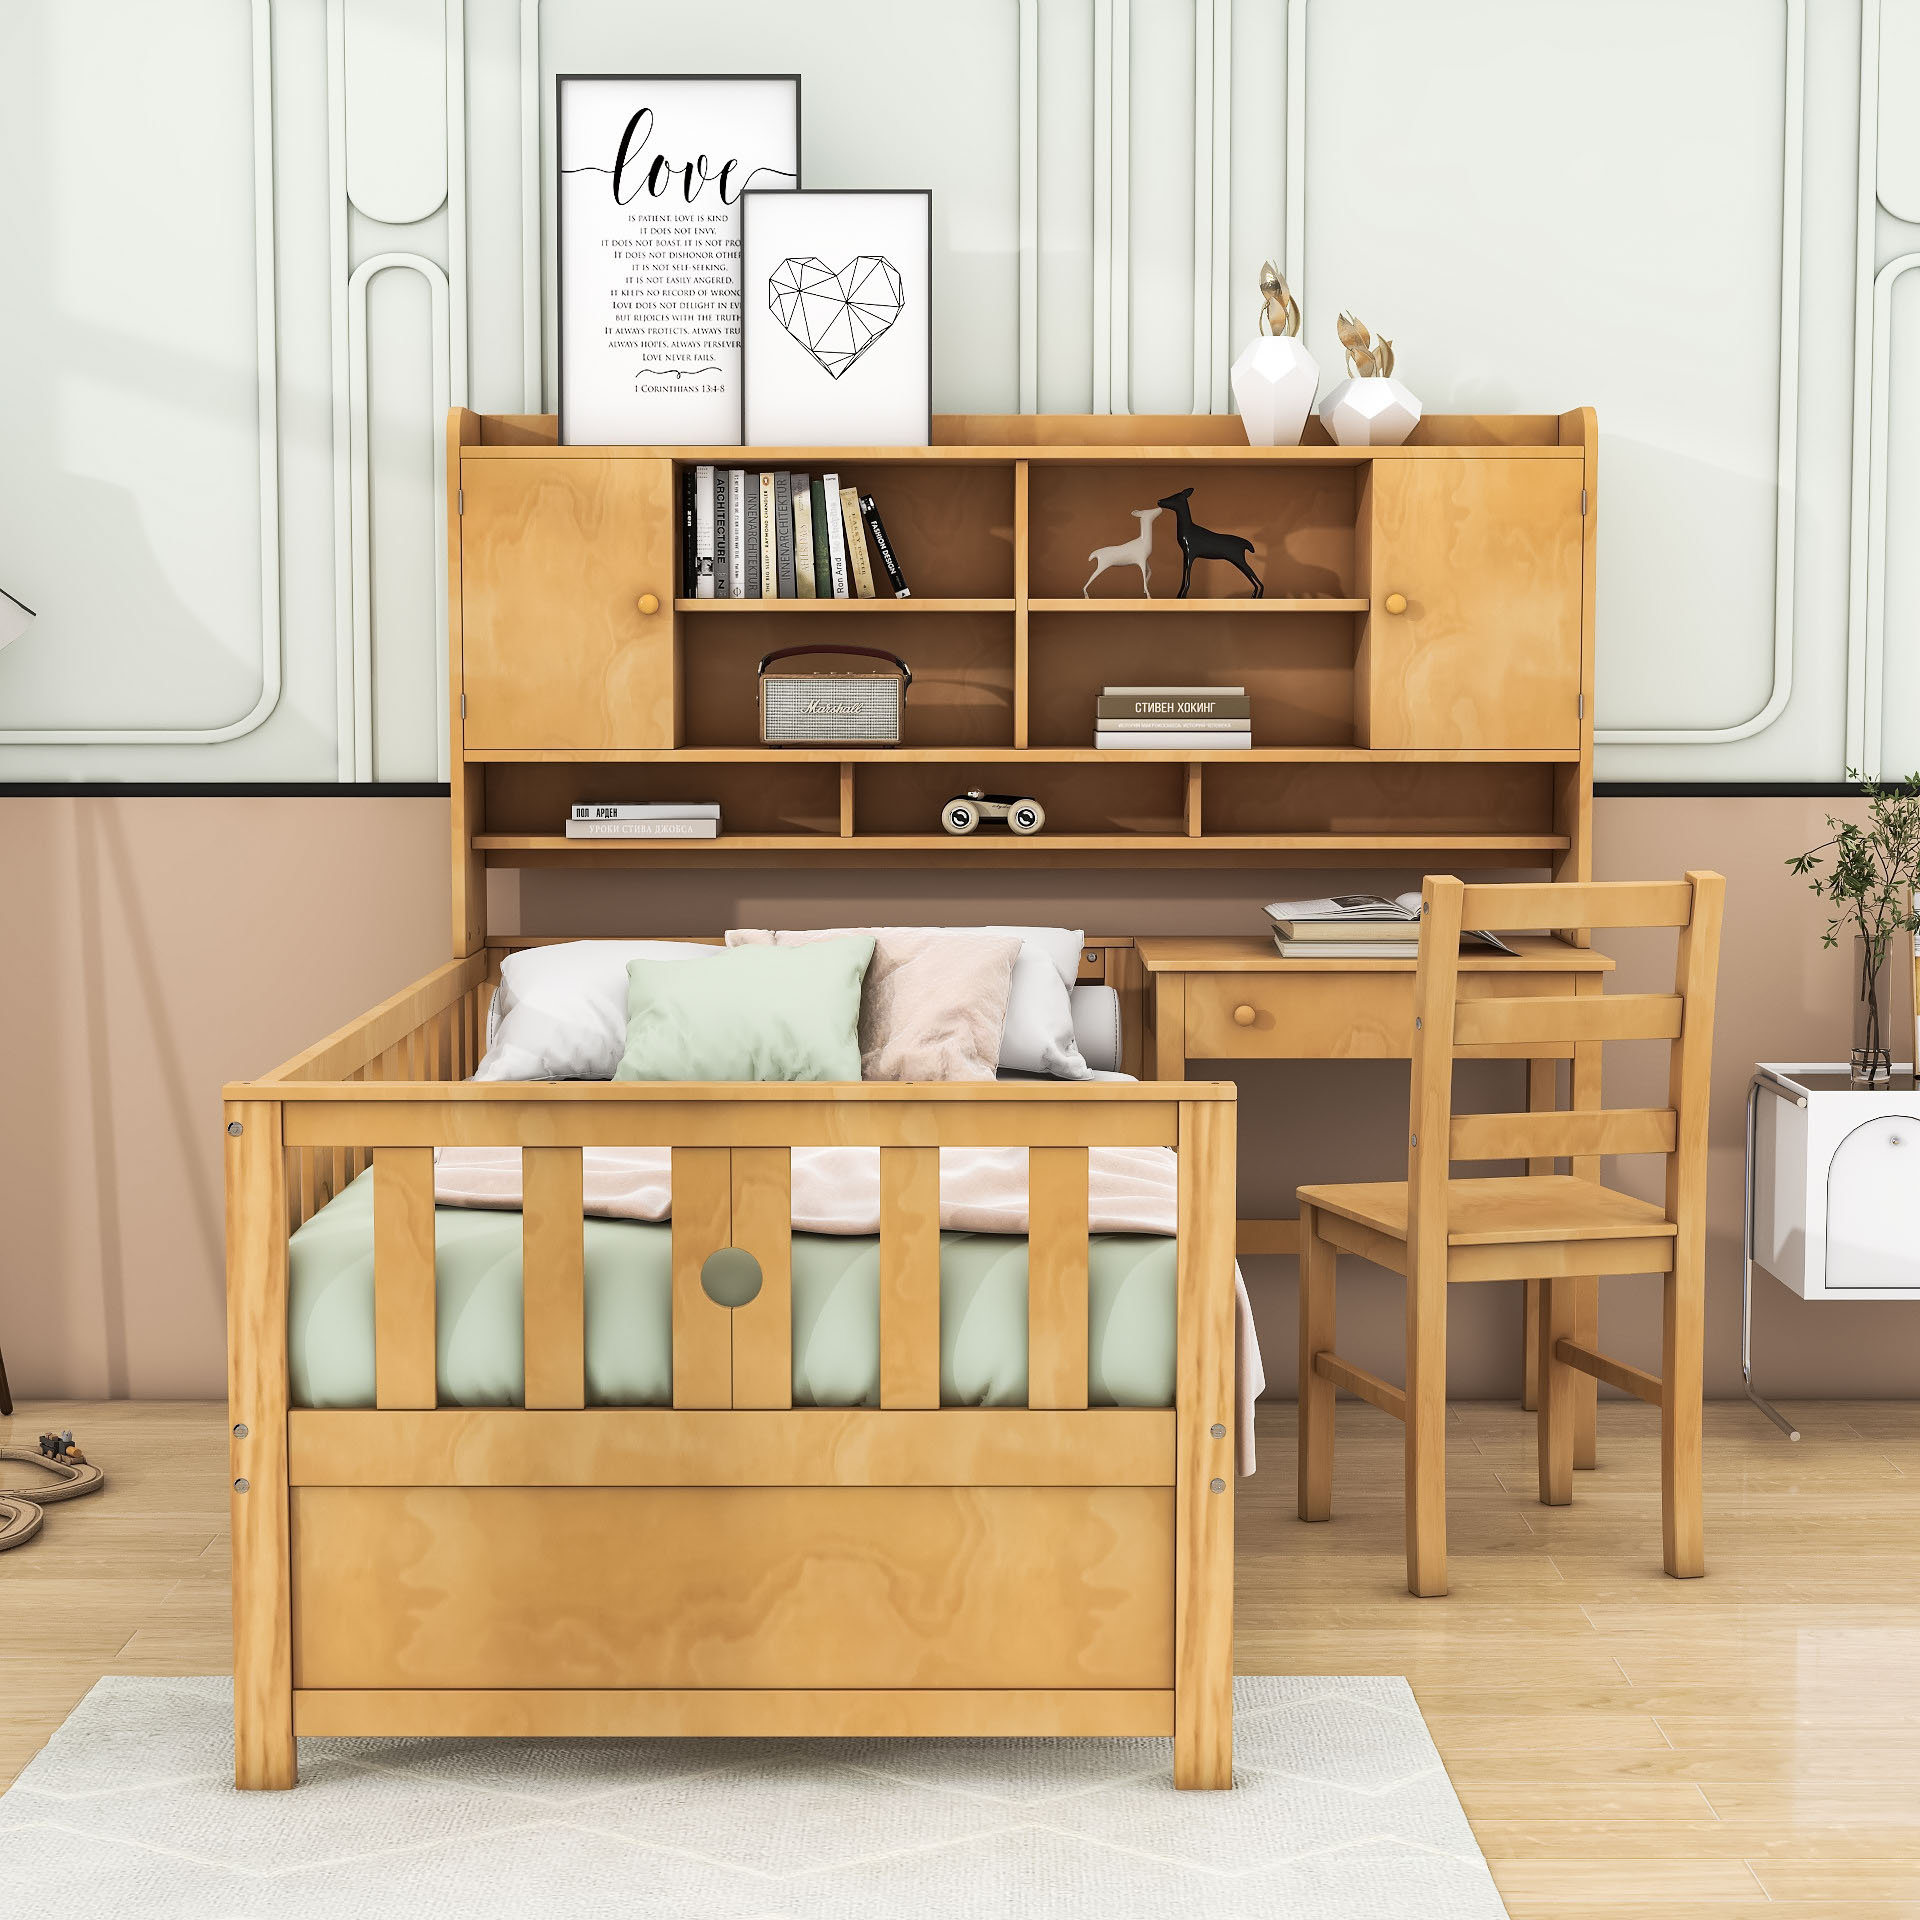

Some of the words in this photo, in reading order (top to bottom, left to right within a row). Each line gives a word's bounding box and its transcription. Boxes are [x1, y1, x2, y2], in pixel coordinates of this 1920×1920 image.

[613, 107, 740, 205] love
[612, 302, 632, 310] LOVE
[660, 302, 676, 310] NOT
[730, 302, 742, 310] EV
[634, 314, 670, 322] REJOICES
[642, 354, 662, 362] LOVE
[666, 354, 692, 362] NEVER
[640, 384, 700, 392] CORINTHIANS
[702, 384, 724, 392] 13:4-8
[716, 479, 726, 564] ARCHITECTURE
[776, 479, 790, 580] INNENARCHITEKTUR
[747, 493, 758, 591] INNENARCHITEKTUR
[870, 520, 886, 550] FASHION
[882, 550, 896, 575] DESIGN
[801, 699, 864, 714] Marshall
[1135, 702, 1174, 713] СТИВЕН
[1178, 702, 1216, 713] ХОКИНГ
[576, 808, 590, 818] ПОЛ
[596, 808, 618, 819] АРДЕН
[589, 824, 619, 834] УРОКИ
[622, 824, 652, 834] СТИВА
[654, 824, 694, 834] ДЖОБСА
